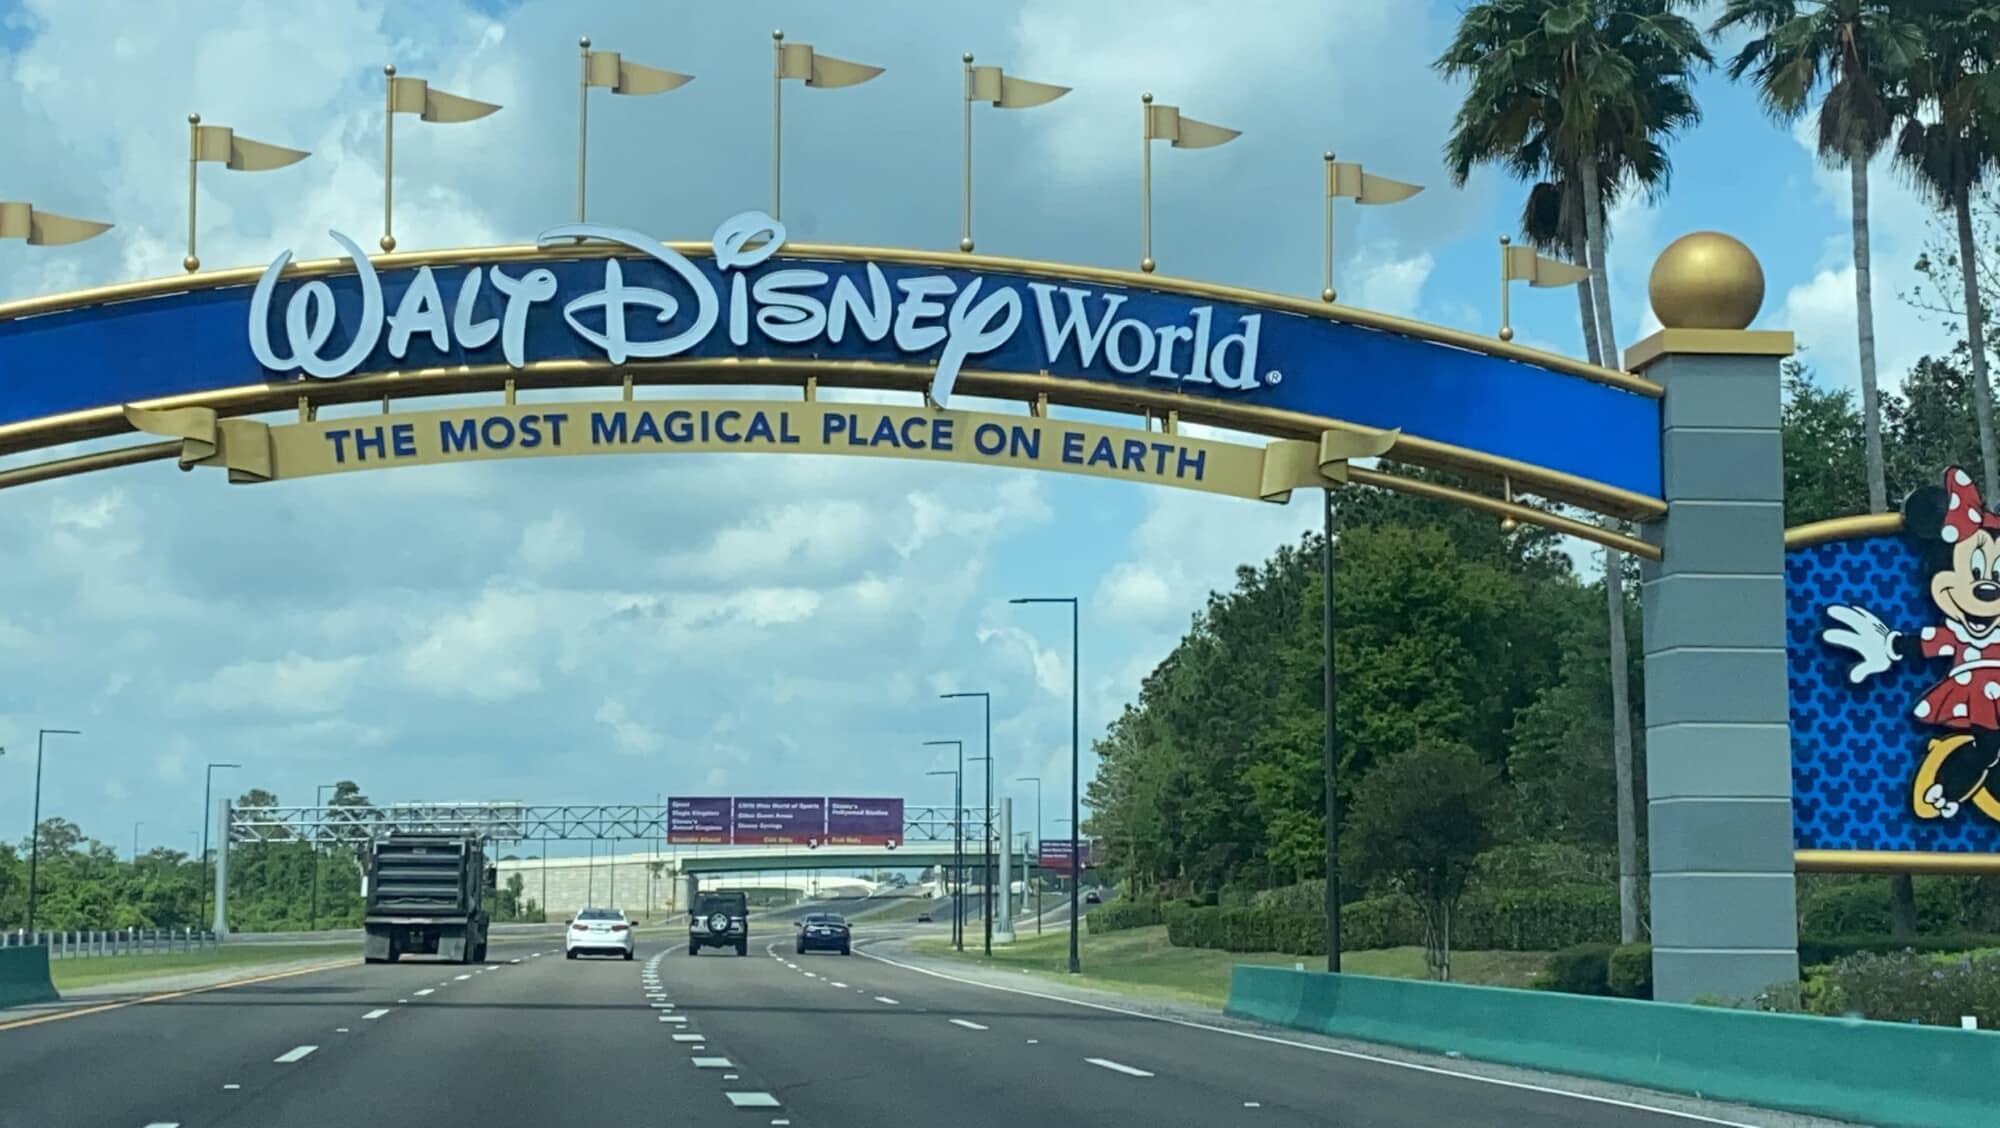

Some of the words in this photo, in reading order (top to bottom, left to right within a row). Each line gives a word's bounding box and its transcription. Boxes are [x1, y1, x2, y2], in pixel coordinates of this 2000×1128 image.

[248, 228, 558, 380] WALT
[536, 210, 1023, 410] DISNEY
[325, 422, 416, 463] THE
[439, 413, 568, 453] MOST
[591, 410, 800, 445] MAGICAL
[822, 413, 954, 451] PLACE
[974, 423, 1041, 460] ON
[1061, 432, 1207, 481] EARTH
